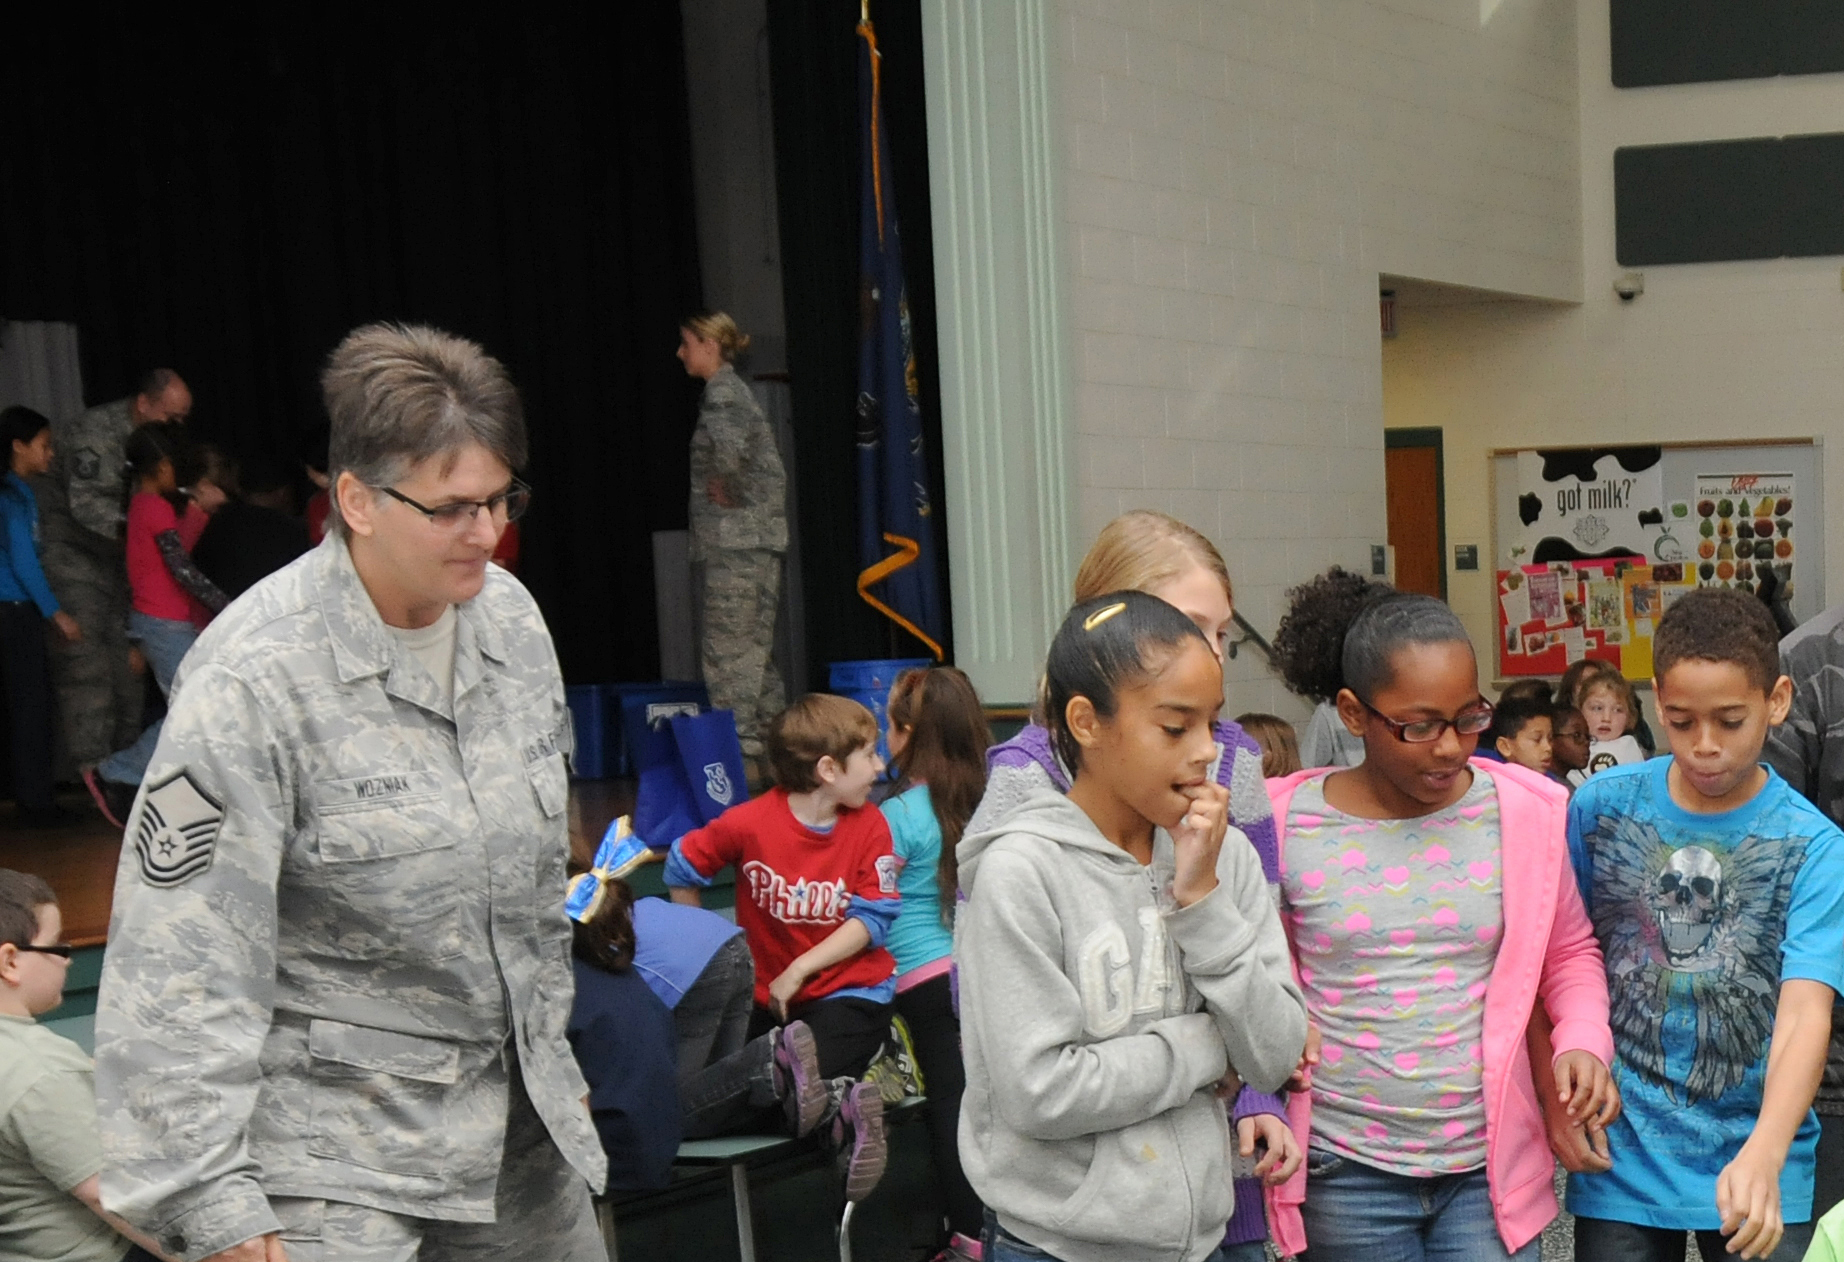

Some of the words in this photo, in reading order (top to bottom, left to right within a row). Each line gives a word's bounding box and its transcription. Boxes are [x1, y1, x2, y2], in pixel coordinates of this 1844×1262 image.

[1557, 482, 1582, 517] got
[1588, 478, 1631, 510] milk?
[1699, 485, 1723, 496] Fruits
[353, 775, 413, 799] WOZNIAK
[742, 860, 853, 924] Philli
[1077, 905, 1188, 1039] GA
